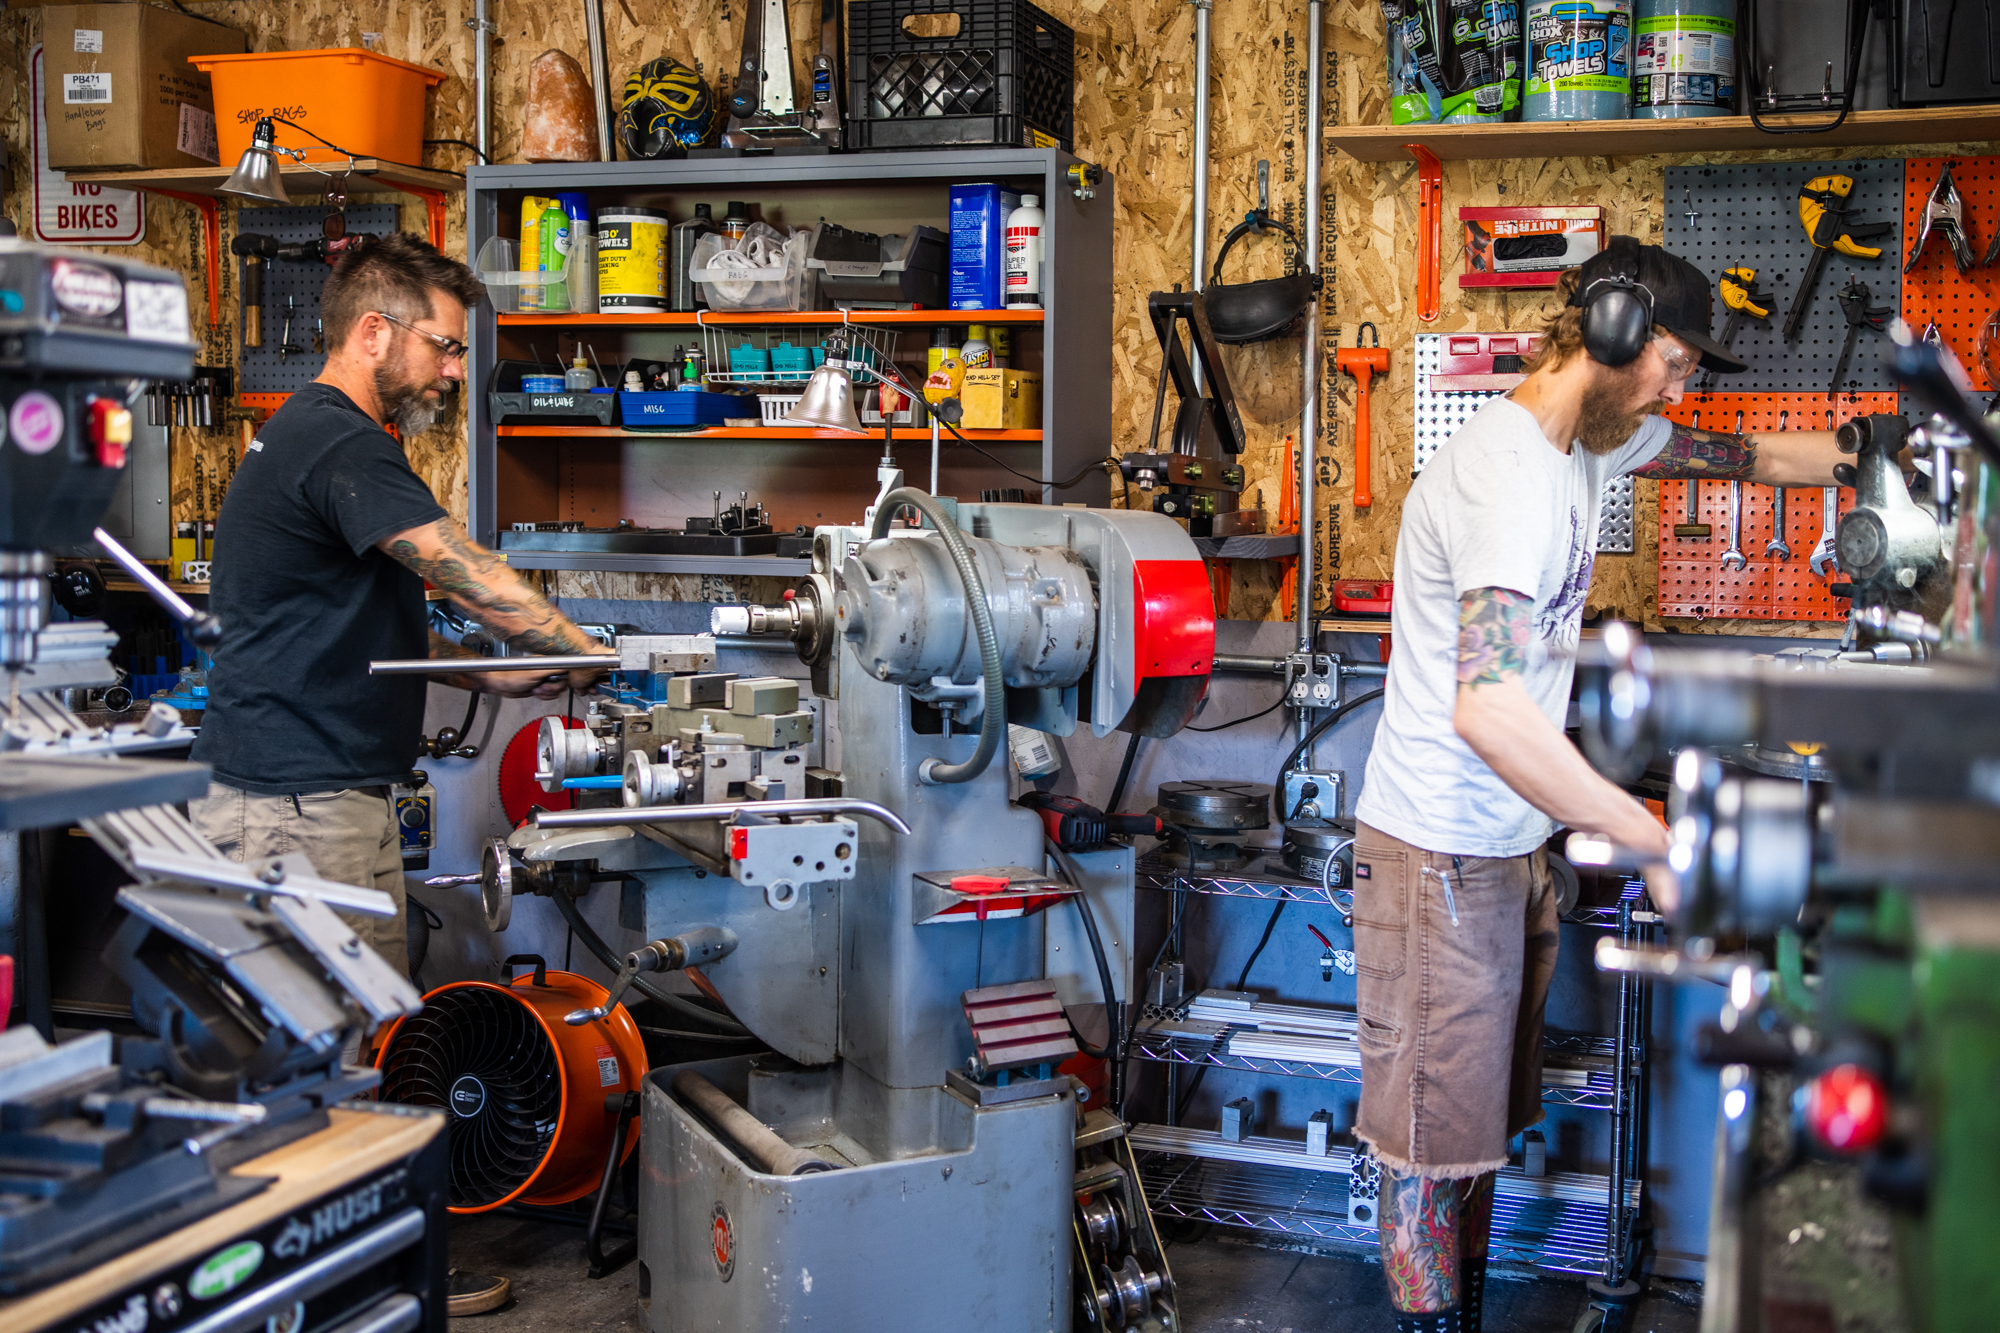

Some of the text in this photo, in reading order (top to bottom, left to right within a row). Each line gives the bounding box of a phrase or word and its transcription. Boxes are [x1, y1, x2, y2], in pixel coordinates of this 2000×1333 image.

[1454, 20, 1469, 37] 6
[1530, 16, 1560, 29] TOOL
[1530, 24, 1564, 40] BOX
[1545, 39, 1604, 65] SHOP
[73, 75, 100, 84] PB471
[1326, 51, 1338, 88] 05:43
[1538, 56, 1604, 83] TOWELS
[1284, 60, 1295, 107] EDGES
[85, 118, 106, 132] Bags
[181, 107, 189, 148] amazon.com
[237, 108, 264, 124] SHOP
[1284, 110, 1295, 136] ALL
[58, 204, 119, 230] BIKES
[1495, 221, 1558, 235] NITRILE
[189, 211, 198, 273] EXPOSURE
[599, 238, 628, 248] OWELS
[1326, 193, 1338, 316] MAY BE REQUIRED
[221, 231, 231, 298] SHEATHING
[1284, 248, 1295, 276] SIDE
[554, 397, 574, 408] LUBE
[1326, 339, 1338, 448] AXE PRINCIPALE
[643, 404, 665, 414] MISC
[194, 454, 204, 511] EXTERIOR
[1321, 456, 1330, 488] APA
[1329, 503, 1340, 569] ADHESIVE
